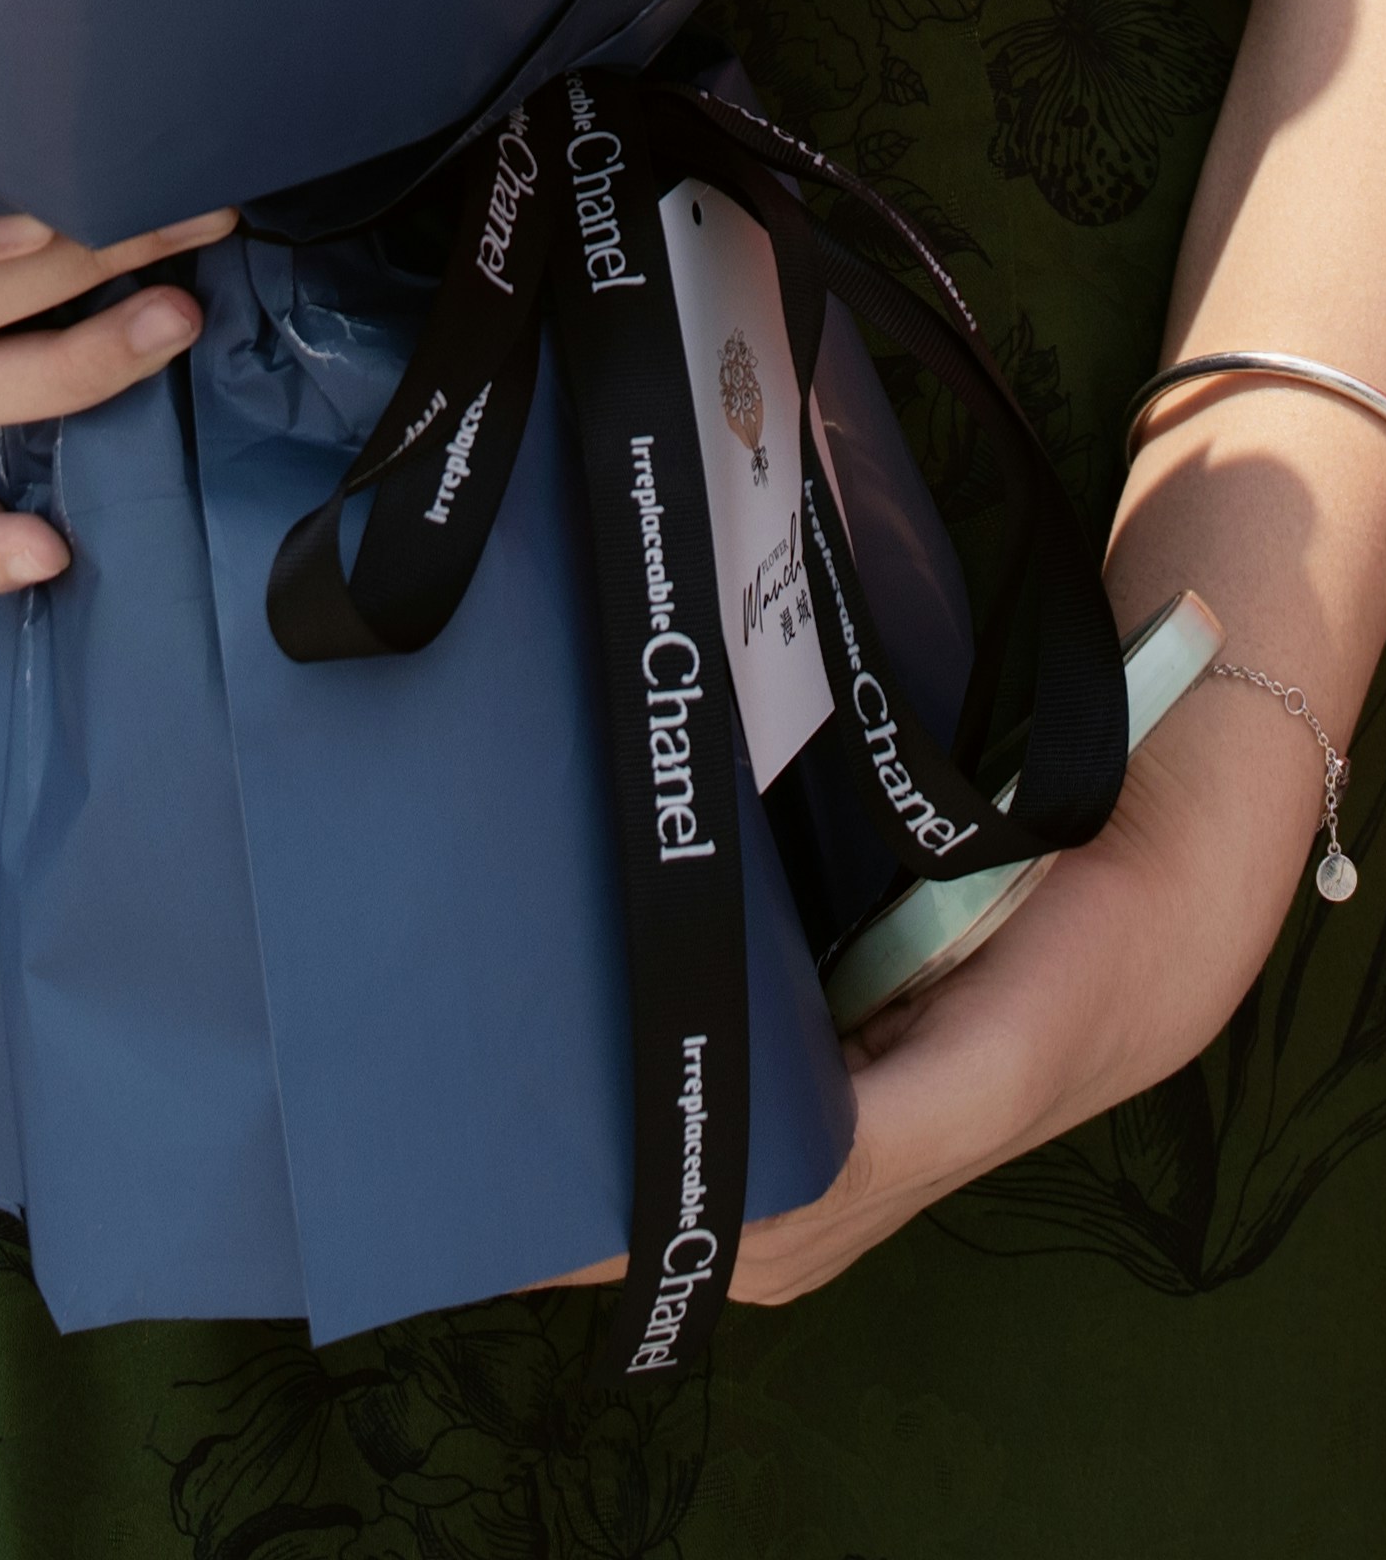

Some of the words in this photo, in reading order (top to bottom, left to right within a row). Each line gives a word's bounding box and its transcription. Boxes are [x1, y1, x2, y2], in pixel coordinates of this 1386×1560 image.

[476, 132, 538, 294] Chanel
[566, 131, 646, 293] Chanel
[630, 435, 675, 632] Irreplaceable
[761, 538, 789, 575] FLOWER
[642, 632, 716, 863] Chanel
[804, 479, 862, 671] Irreplaceable
[853, 671, 979, 856] Chanel
[678, 1034, 709, 1229] Irreplaceable
[625, 1228, 718, 1373] Chanel
